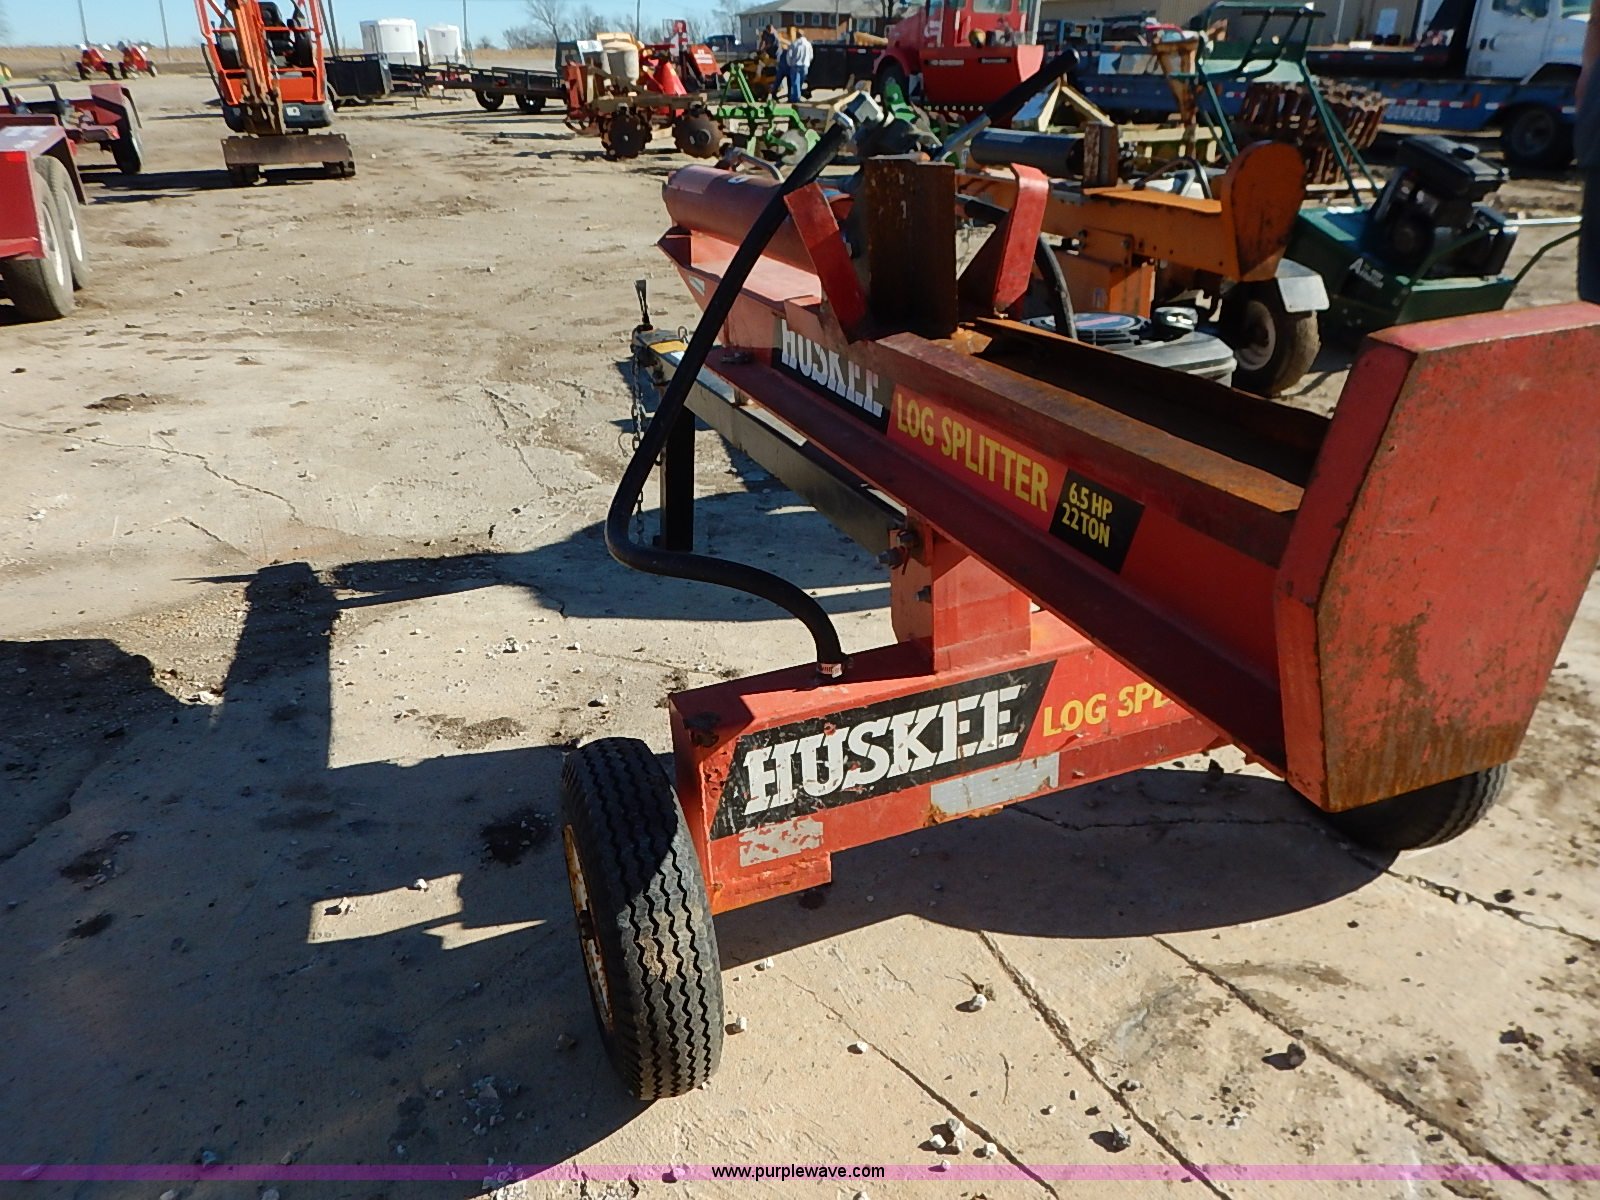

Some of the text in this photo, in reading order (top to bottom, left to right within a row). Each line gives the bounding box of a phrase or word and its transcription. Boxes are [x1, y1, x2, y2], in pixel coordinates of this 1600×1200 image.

[897, 393, 1049, 512] LOG SPLITTER
[1091, 492, 1113, 520] HP
[742, 684, 1023, 816] HUSKEE
[1042, 692, 1107, 737] LOG
